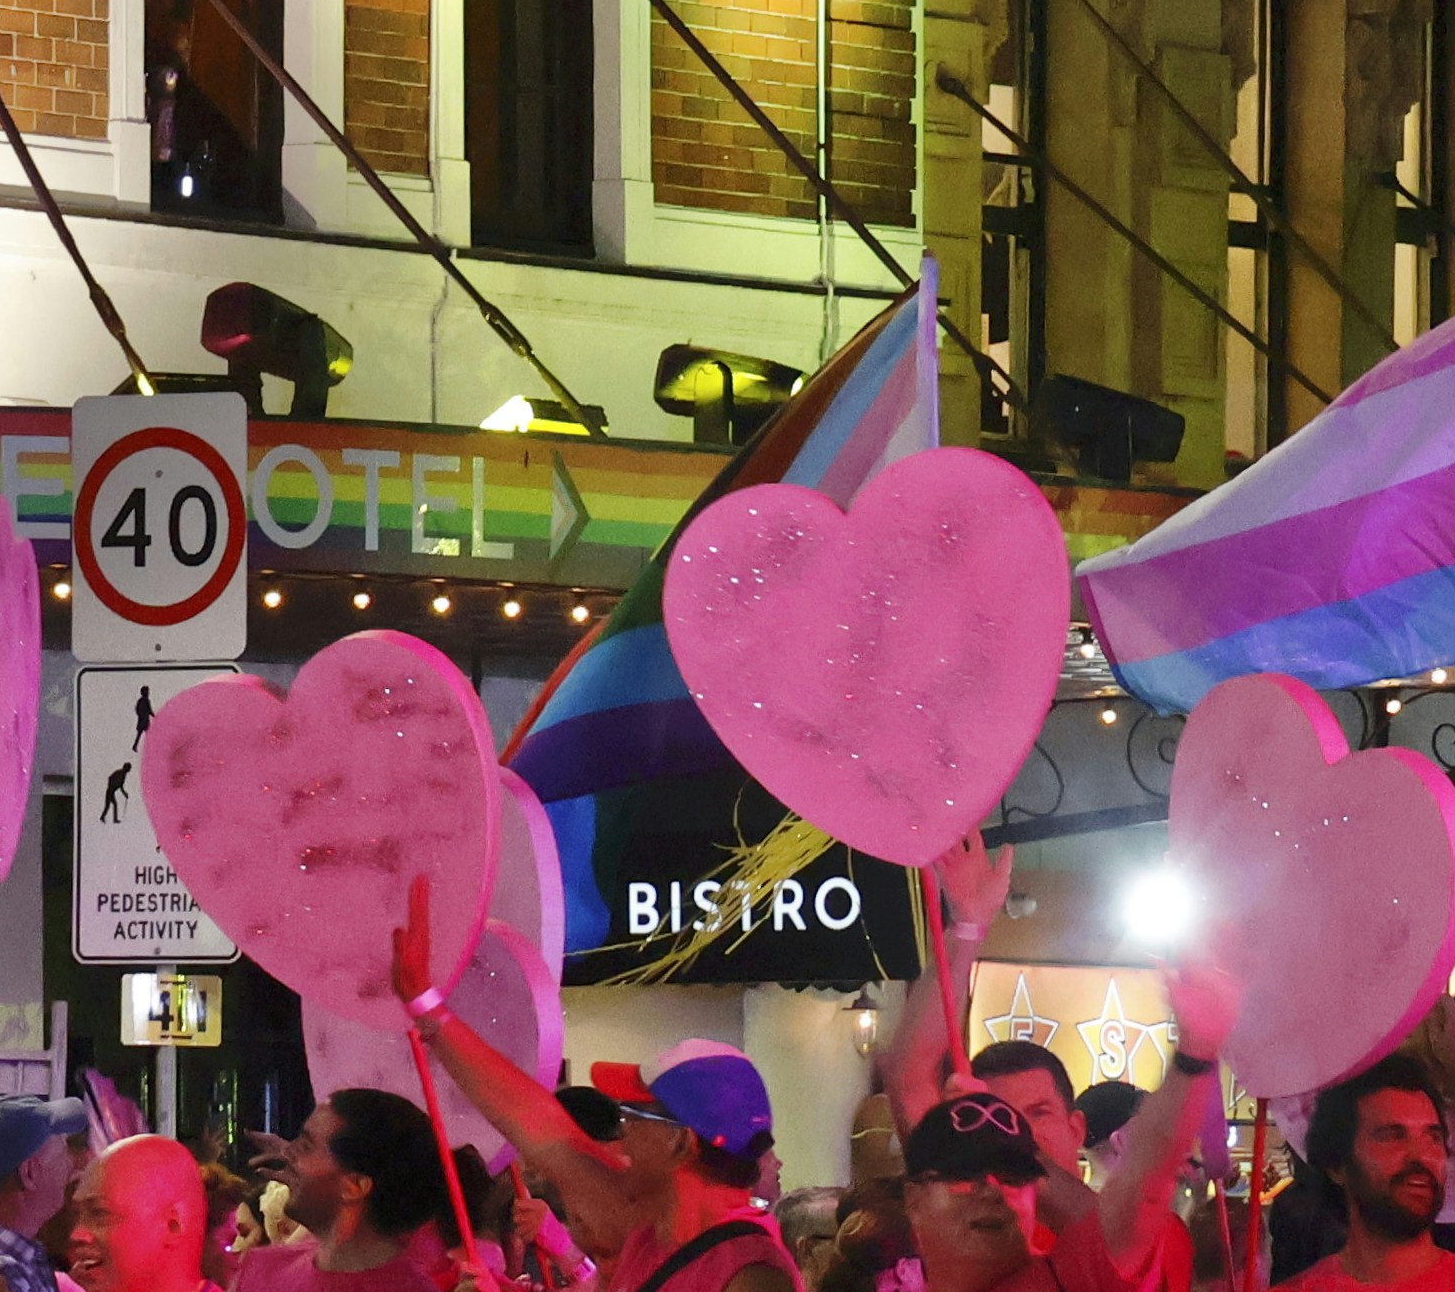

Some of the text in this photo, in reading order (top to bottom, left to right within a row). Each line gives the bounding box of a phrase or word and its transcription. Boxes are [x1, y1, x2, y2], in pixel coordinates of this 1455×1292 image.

[101, 484, 218, 568] 40
[252, 443, 515, 560] OTEL
[97, 893, 202, 913] PEDESTRIA
[113, 920, 199, 940] ACTIVITY
